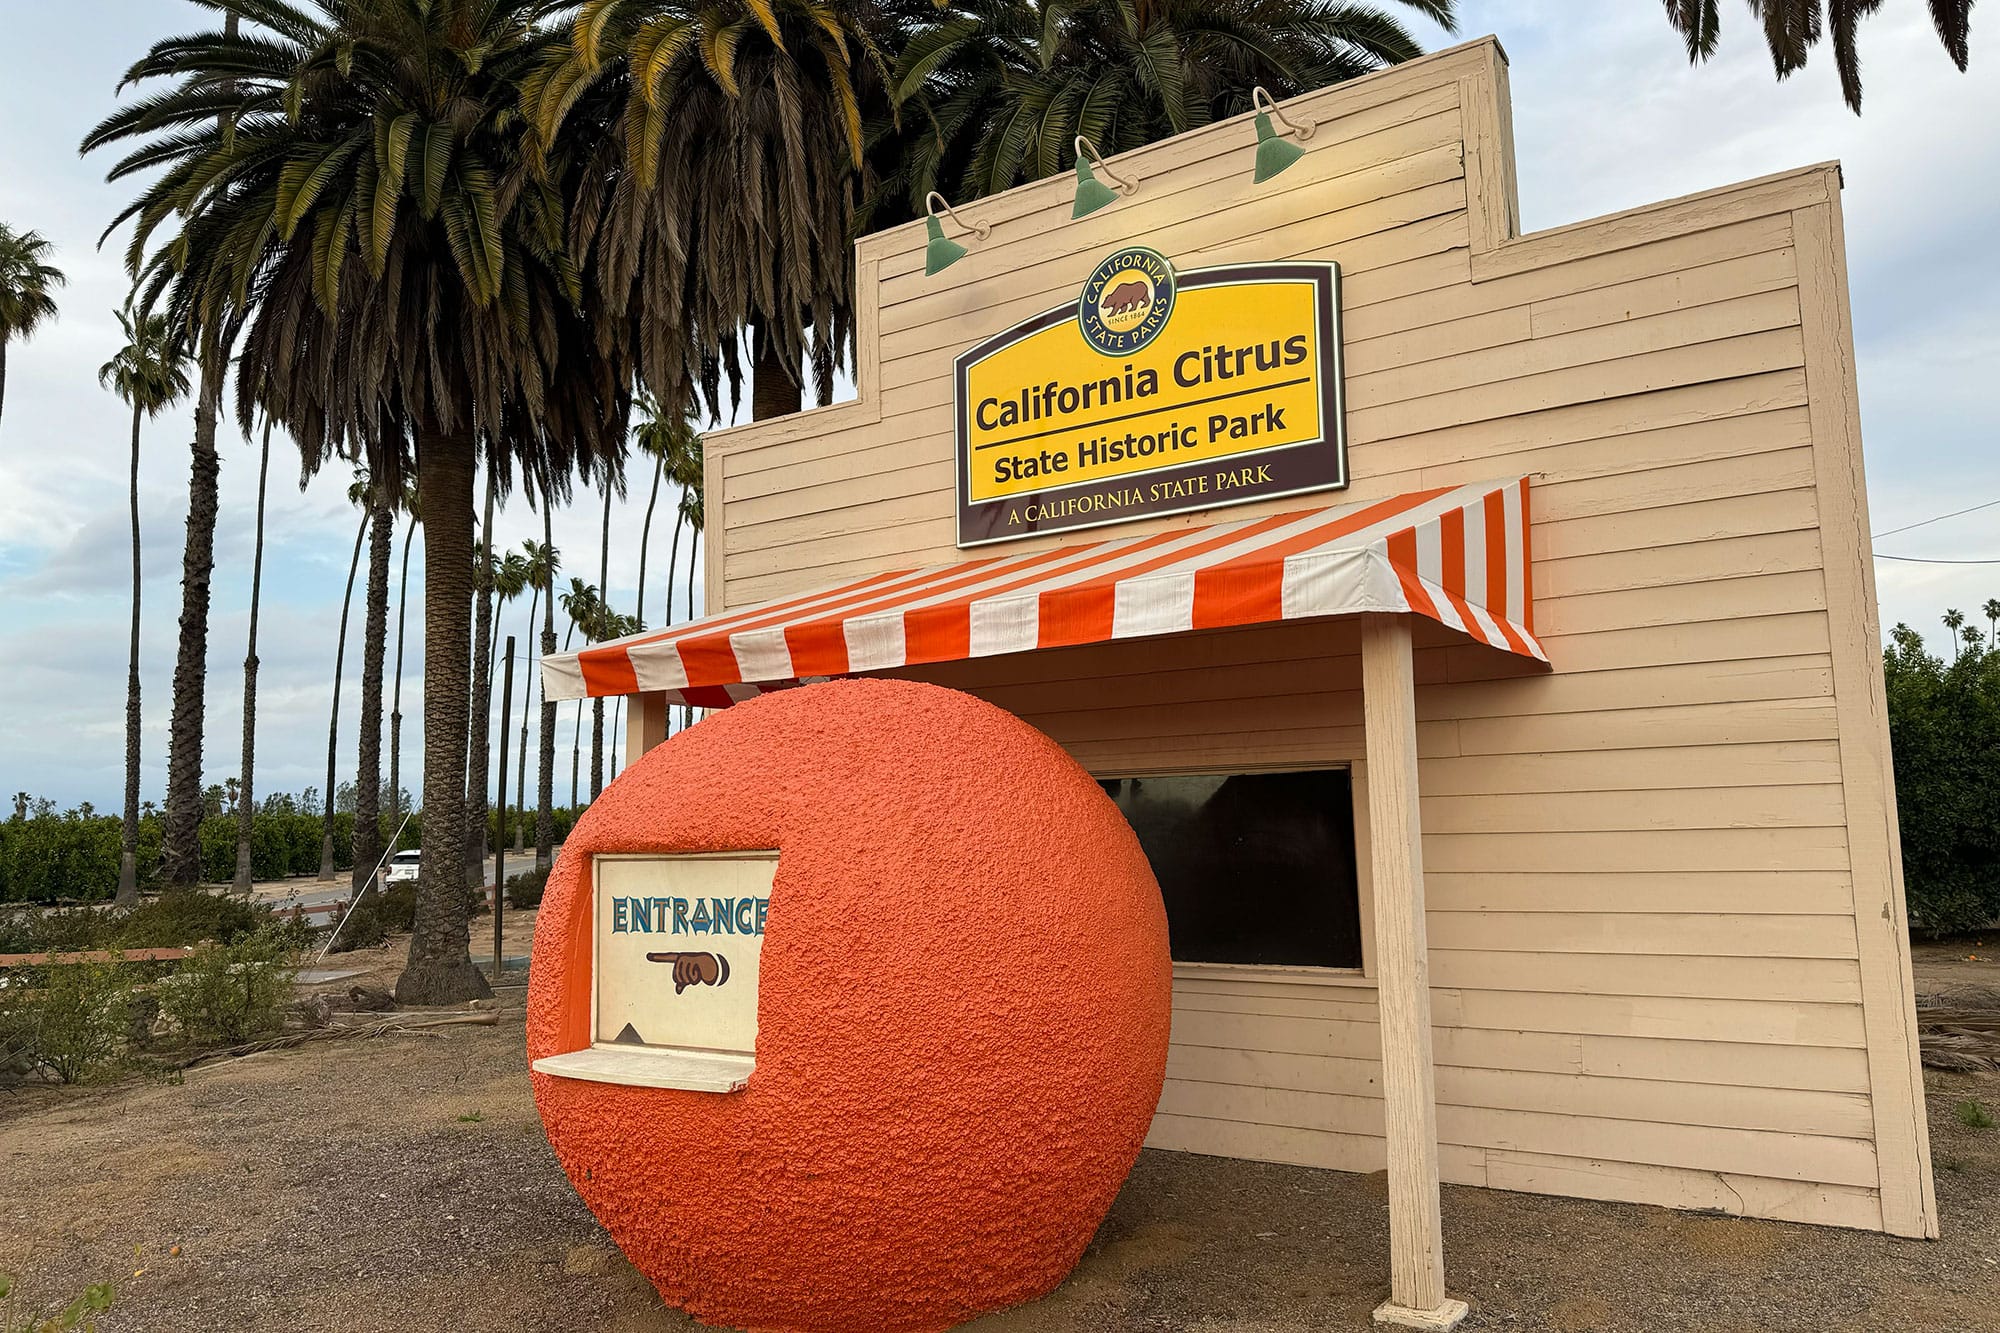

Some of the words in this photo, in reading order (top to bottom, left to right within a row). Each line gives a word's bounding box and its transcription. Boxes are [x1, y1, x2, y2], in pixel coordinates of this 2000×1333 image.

[1087, 255, 1166, 304] CALIFORNIA
[1086, 316, 1124, 348] STATE
[1131, 297, 1167, 343] PARKS
[1108, 315, 1128, 325] SINCE
[975, 364, 1158, 430] California
[1173, 334, 1307, 387] Citrus
[994, 450, 1068, 483] State
[1078, 422, 1197, 468] Historic
[1208, 403, 1286, 442] Park
[1008, 510, 1021, 525] A
[1024, 487, 1144, 523] CALIFORNIA
[1149, 478, 1208, 504] STATE
[1215, 463, 1274, 492] PARK
[612, 895, 769, 937] ENTRANCE
